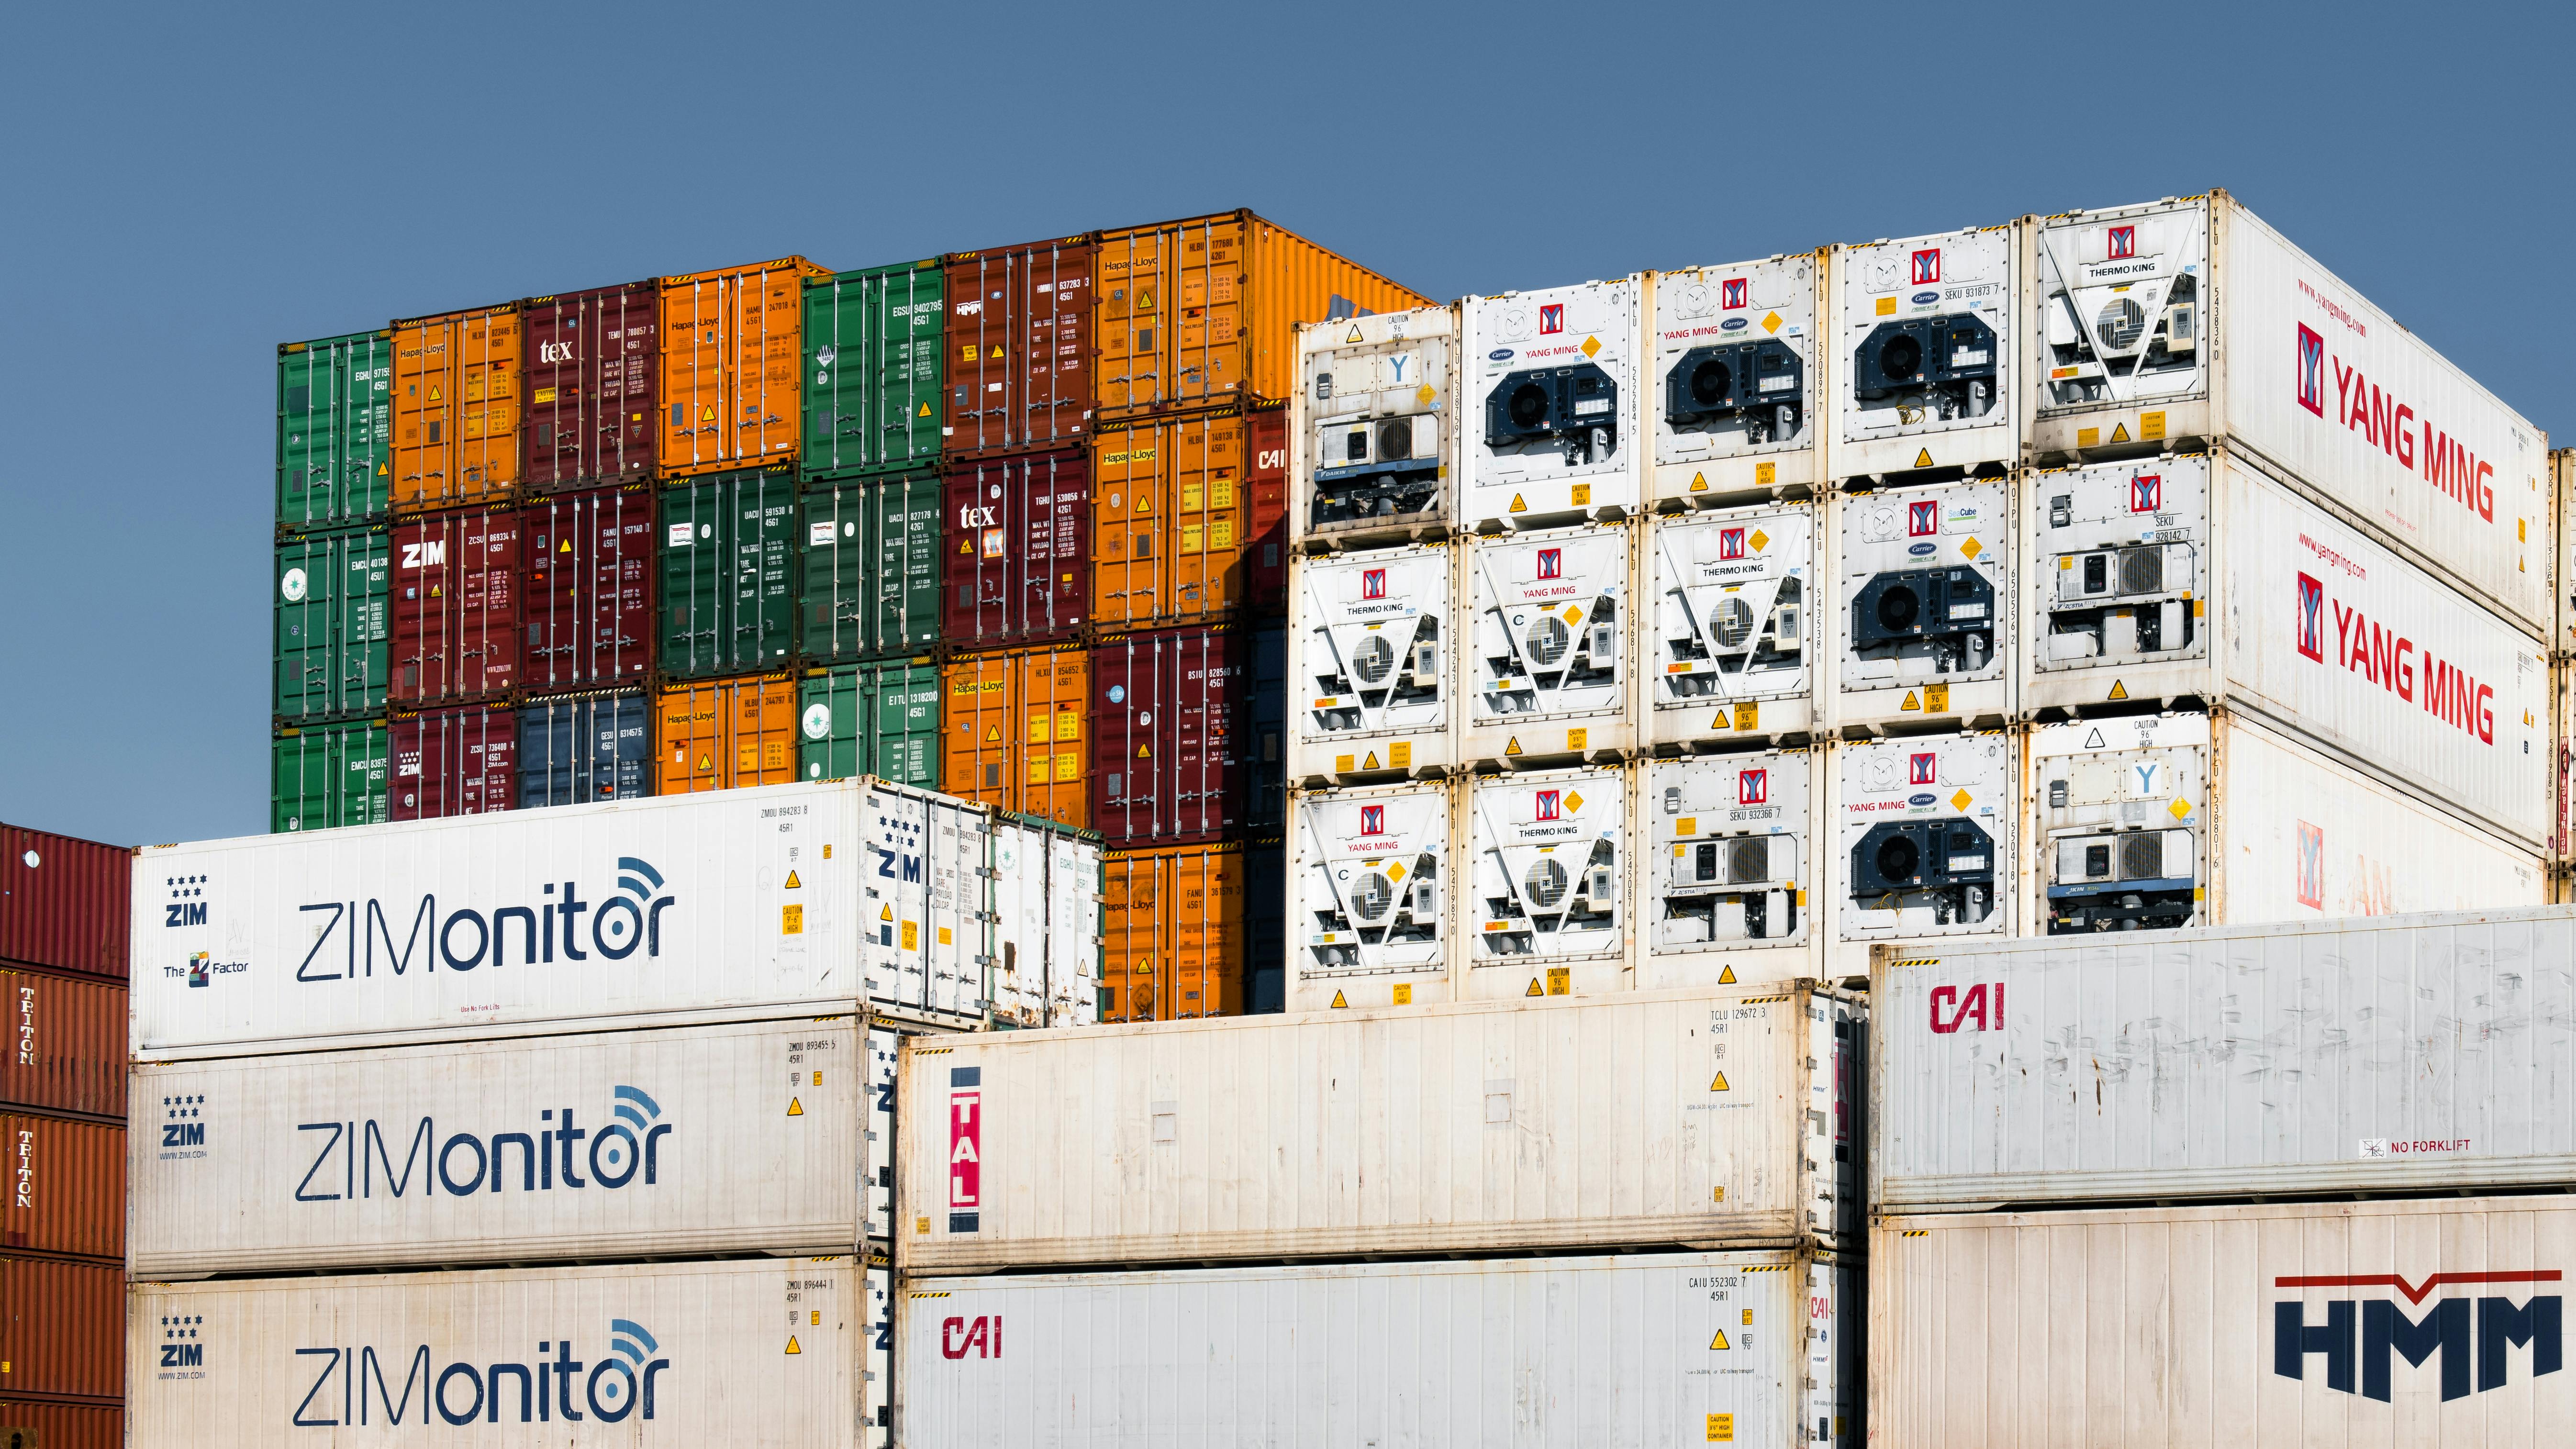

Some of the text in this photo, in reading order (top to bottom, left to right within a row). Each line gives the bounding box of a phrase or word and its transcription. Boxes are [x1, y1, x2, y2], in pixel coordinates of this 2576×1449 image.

[2090, 263, 2155, 277] THERMO KING
[1037, 277, 1089, 294] HMMU 637283 3
[1059, 291, 1073, 301] 45G1
[1945, 285, 1998, 301] SEKU 931873 7
[957, 301, 981, 315] HMM
[2298, 278, 2366, 338] www.yangming.com
[913, 315, 929, 325] 45G1
[608, 325, 654, 340] TEMU 780857 3
[627, 341, 640, 349] 45G1
[1526, 346, 1578, 358] YANG MING
[1390, 355, 1407, 382] Y
[1632, 426, 1636, 435] 5
[2333, 354, 2493, 524] YANG MING
[1326, 469, 1346, 478] DAIKIN
[1036, 490, 1086, 505] TGHU 530056 4
[889, 509, 939, 523] UACU 827179 4
[1948, 508, 1976, 517] SeaCube
[2156, 517, 2173, 526] SEKU
[468, 531, 516, 545] ZCSU 869334 4
[2156, 529, 2190, 542] 928142 7
[402, 540, 443, 568] ZIM
[2298, 531, 2366, 581] www.yangming.com
[2011, 635, 2015, 644] 2
[1188, 666, 1240, 680] BSIU 828560 6
[2332, 598, 2493, 746] YANG MING
[1209, 679, 1224, 688] 45G1
[1925, 684, 1948, 693] CAUTION
[910, 708, 926, 718] 45G1
[1735, 702, 1757, 712] CAUTION
[1930, 703, 1943, 713] HIGH
[1740, 722, 1752, 730] HIGH
[470, 741, 514, 754] ZCSU 736400 4
[400, 763, 419, 776] ZIM
[2136, 765, 2157, 793] Y
[761, 805, 807, 818] ZMOU 894283 8
[1849, 801, 1905, 812] YANG MING
[1519, 826, 1577, 837] THERMO KING
[879, 849, 920, 883] ZM
[2010, 885, 2014, 894] 4
[166, 902, 207, 927] ZIM
[783, 907, 803, 915] CAUTION
[296, 881, 675, 982] ZIMonitor
[788, 925, 798, 933] HIGH
[164, 967, 184, 978] The
[213, 962, 248, 973] Factor
[1711, 1008, 1766, 1020] TCLU 129672 3
[1930, 982, 2004, 1034] CAI
[20, 988, 34, 1065] TRITON
[1711, 1025, 1728, 1033] 45R1
[789, 1039, 836, 1052] ZMOU 893455 5
[789, 1055, 803, 1064] 45R1
[163, 1123, 204, 1147] ZIM
[951, 1096, 979, 1204] TAL
[2392, 1139, 2471, 1153] NO FORKLIFT
[160, 1151, 207, 1159] WWW.ZIM.COM
[294, 1108, 671, 1203] ZIMonitor
[17, 1131, 32, 1207] TRITON
[787, 1279, 833, 1290] ZMOU 896444 1
[1689, 1276, 1746, 1288] CAIU 552302 7
[1711, 1292, 1728, 1301] 45R1
[1811, 1297, 1828, 1319] CAI
[943, 1315, 1002, 1360] CAI
[161, 1344, 202, 1367] ZIM
[2275, 1295, 2562, 1404] HMM
[158, 1371, 205, 1380] WWW.ZIM.COM
[292, 1340, 669, 1427] ZIMonitor
